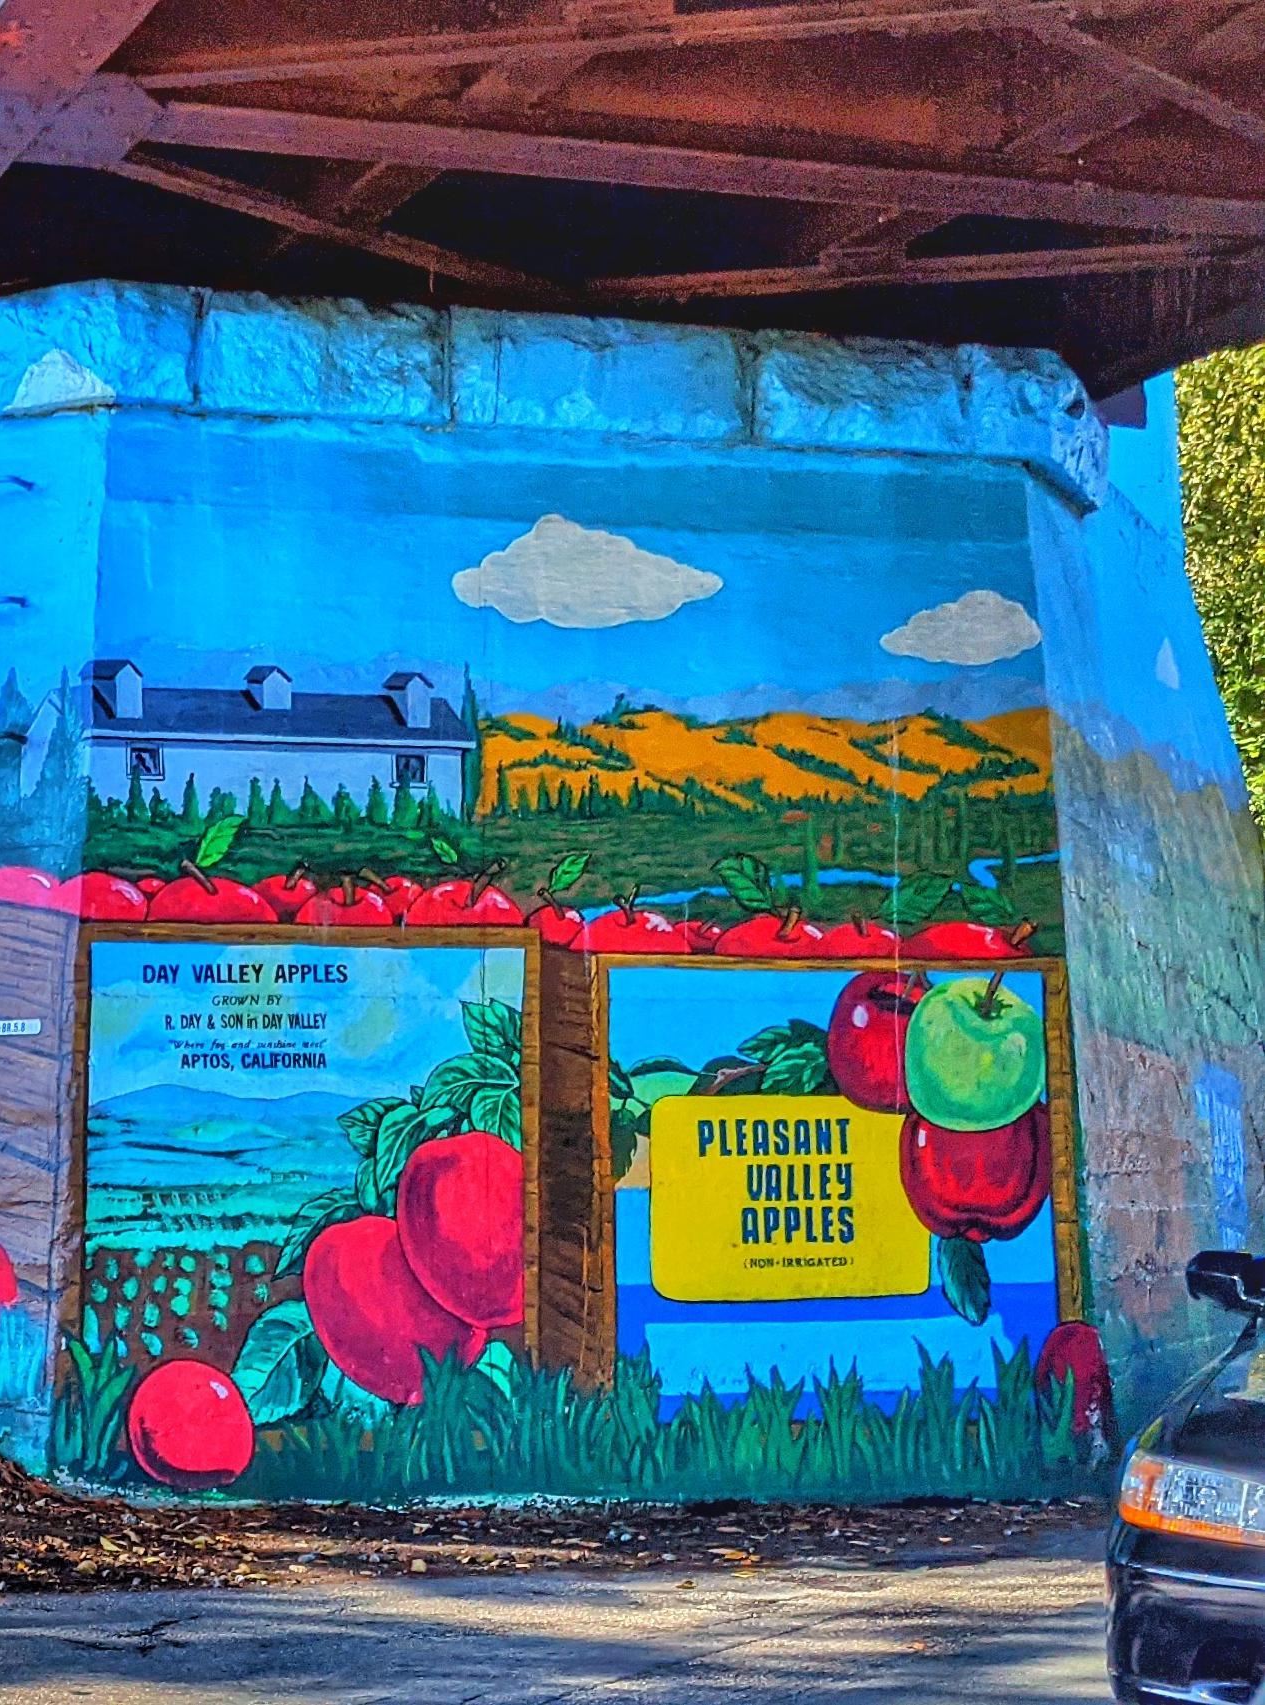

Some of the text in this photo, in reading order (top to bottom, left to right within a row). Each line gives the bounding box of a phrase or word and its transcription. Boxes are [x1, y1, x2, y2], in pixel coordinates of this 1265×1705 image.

[142, 963, 349, 984] DAY VALLEY APPLES
[211, 994, 283, 1006] GROWN BY
[165, 1012, 328, 1030] R. DAY & SON in DAY VALLEY
[210, 1038, 226, 1050] fog
[230, 1039, 252, 1049] and
[257, 1039, 297, 1049] sunshine
[181, 1052, 328, 1071] APTOS, CALIFORNIA
[697, 1118, 851, 1157] PLEASANT
[746, 1162, 853, 1202] VALLEY
[741, 1206, 855, 1244] APPLES
